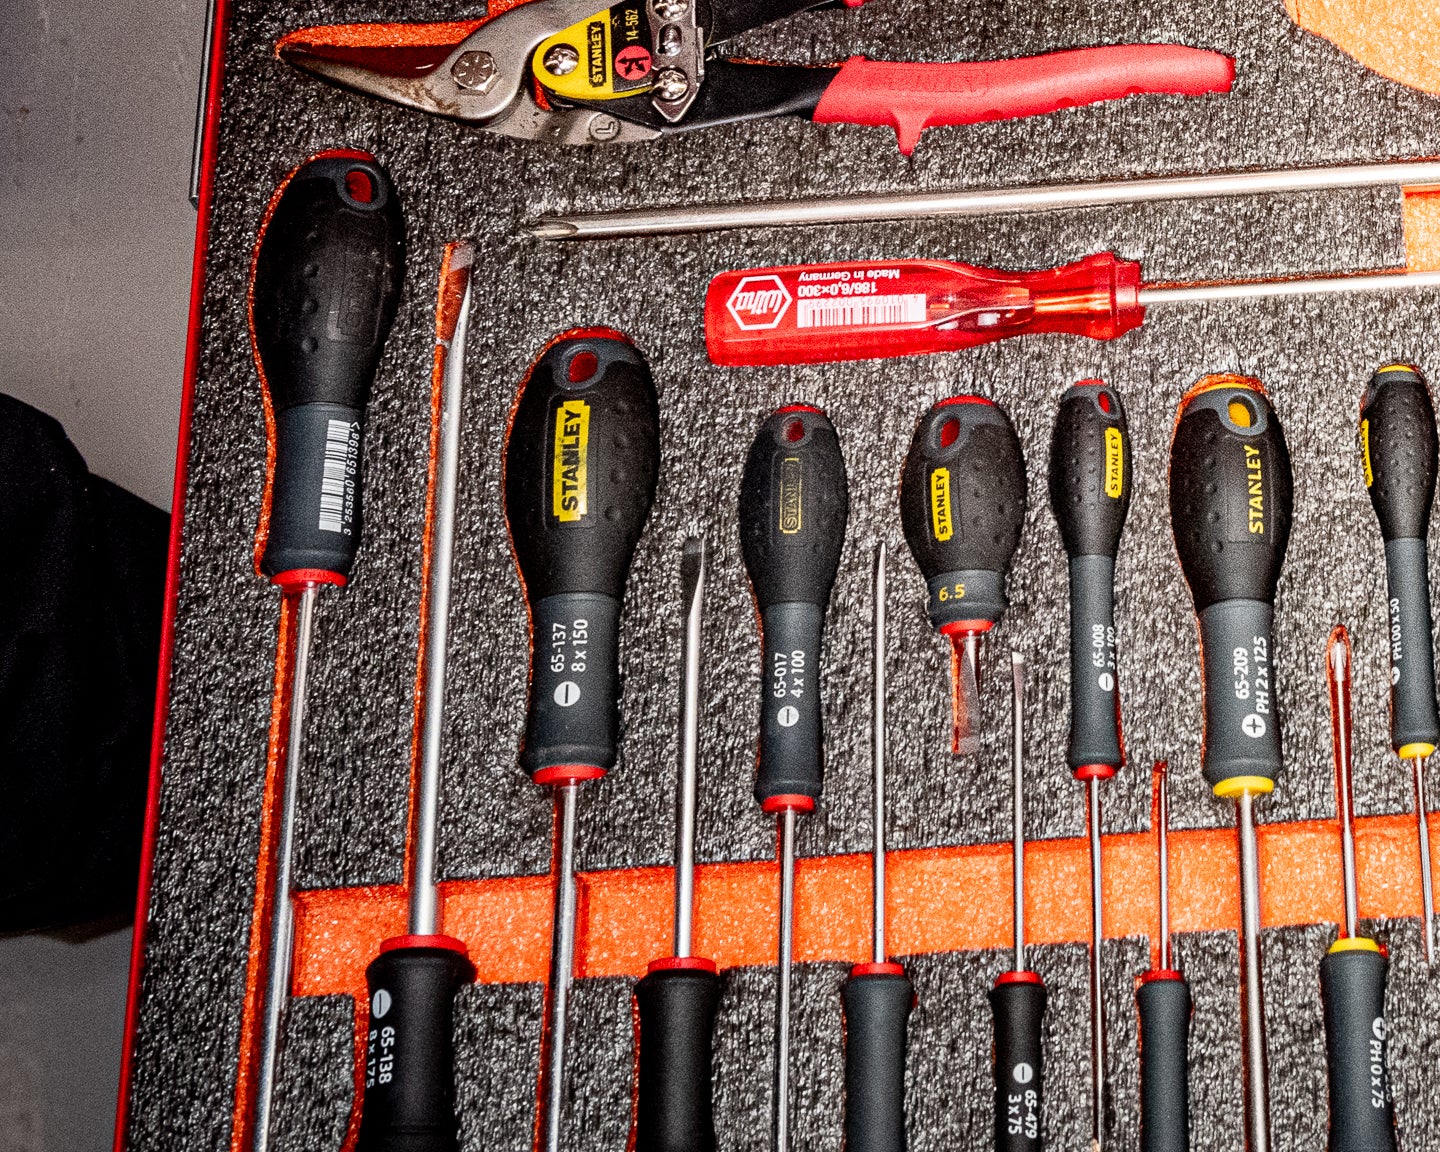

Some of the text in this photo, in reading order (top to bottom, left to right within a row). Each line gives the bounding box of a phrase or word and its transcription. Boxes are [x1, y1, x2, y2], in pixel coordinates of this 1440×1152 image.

[625, 9, 639, 41] 14-562
[591, 24, 603, 83] STANLEY
[798, 269, 900, 281] Made in Germany
[736, 290, 782, 314] Wiha
[346, 433, 361, 475] 651398
[561, 409, 582, 511] STANLEY
[1110, 434, 1119, 490] STANLEY
[344, 479, 356, 523] 253560
[936, 474, 948, 535] STANLEY
[1243, 444, 1264, 535] STANLEY
[939, 583, 965, 602] 6.5
[550, 622, 567, 673] 65-137
[571, 619, 589, 673] 8 x 150
[1092, 623, 1105, 667] 65-008
[1106, 626, 1115, 647] 100
[773, 652, 788, 698] 65-017
[791, 650, 806, 675] 100
[1233, 647, 1250, 700] 65-209
[790, 688, 804, 698] 4
[366, 1029, 378, 1088] 8 x 175
[378, 1026, 396, 1085] 65-138
[1024, 1089, 1038, 1139] 65-479
